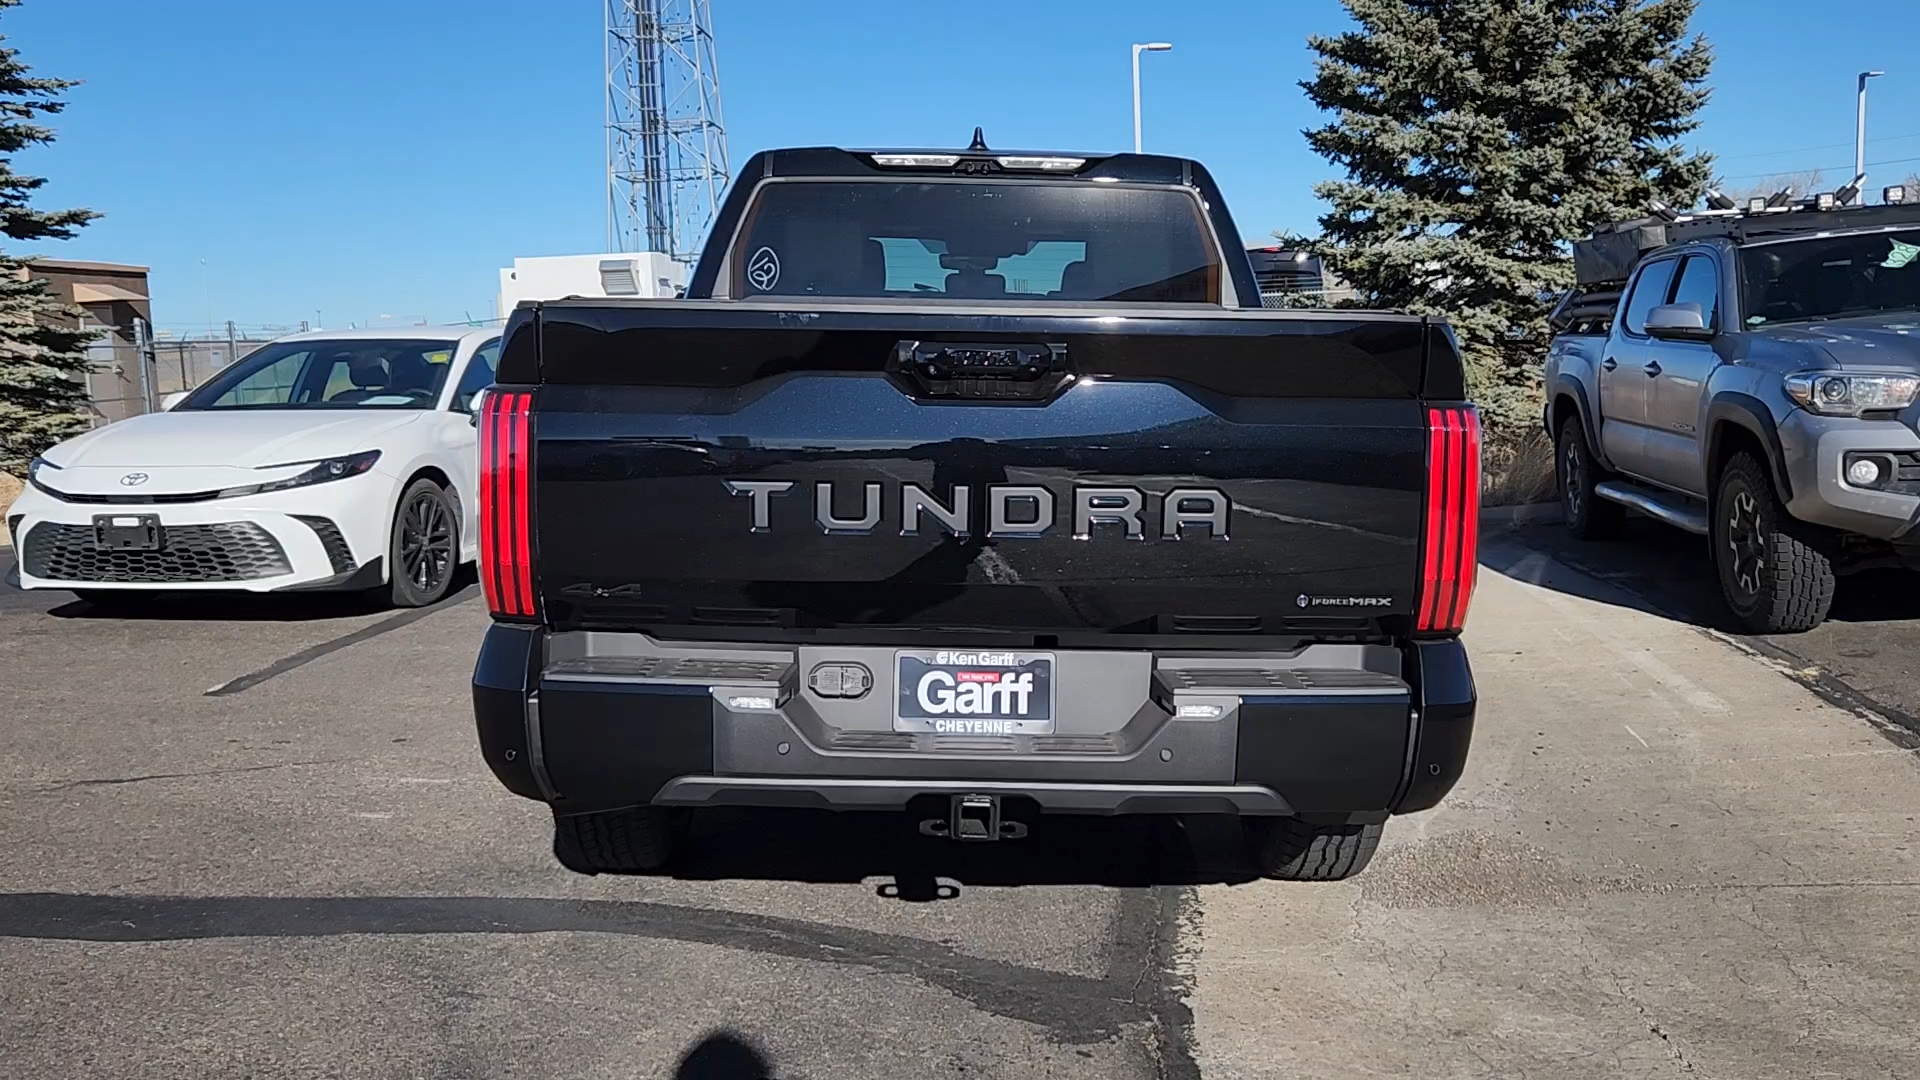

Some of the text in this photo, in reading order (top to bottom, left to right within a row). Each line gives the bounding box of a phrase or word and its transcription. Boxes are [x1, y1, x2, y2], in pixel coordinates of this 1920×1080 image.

[727, 480, 1232, 541] TUNDRA
[918, 670, 1034, 714] Garff
[936, 720, 1012, 733] CHEYENNE
